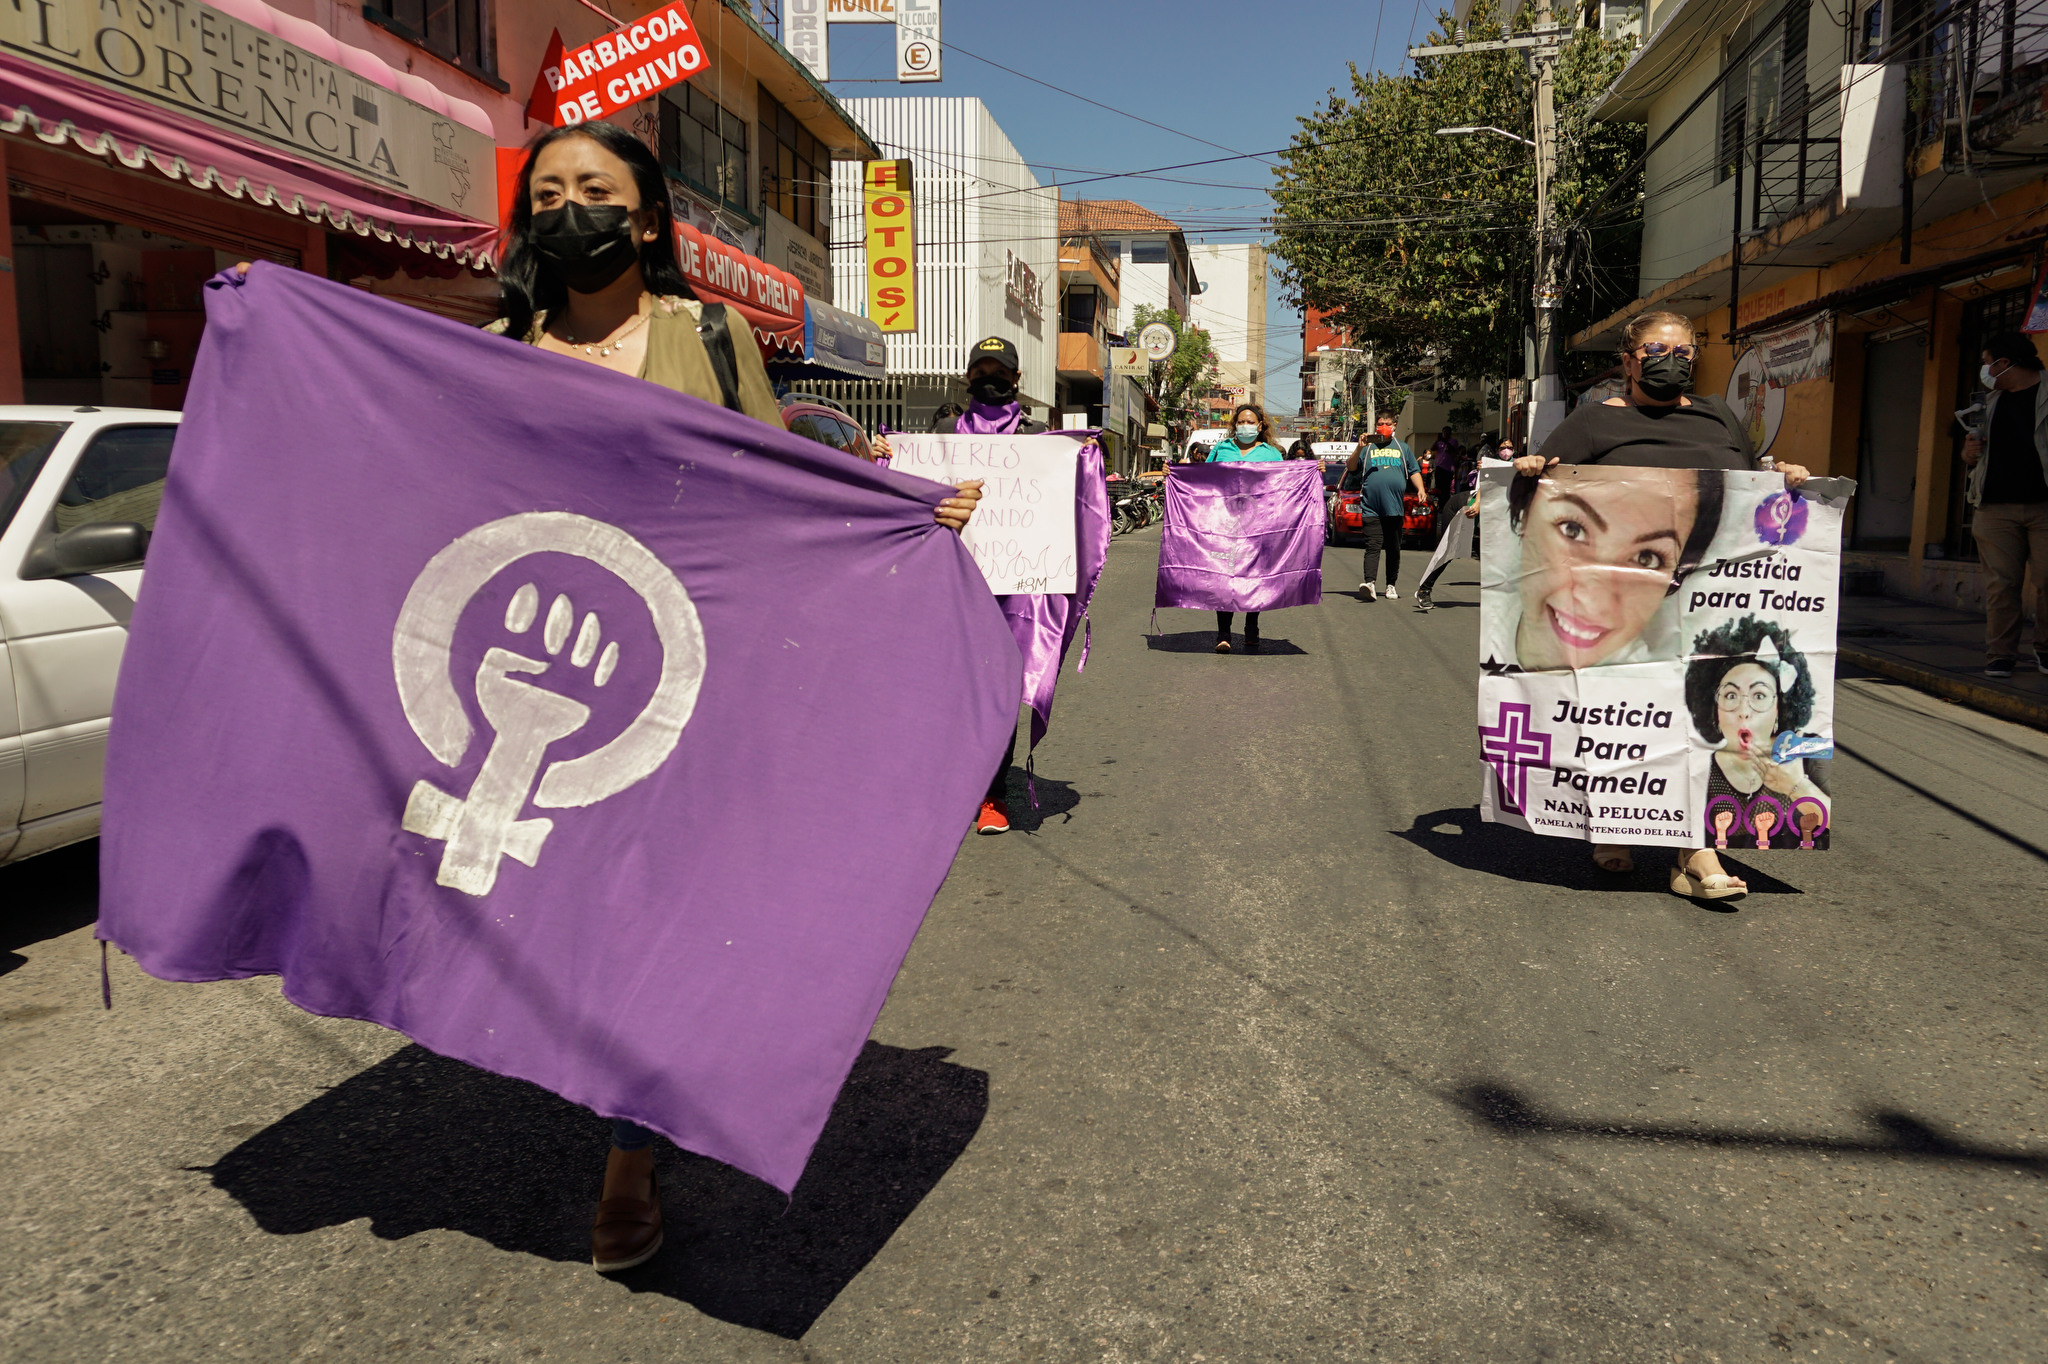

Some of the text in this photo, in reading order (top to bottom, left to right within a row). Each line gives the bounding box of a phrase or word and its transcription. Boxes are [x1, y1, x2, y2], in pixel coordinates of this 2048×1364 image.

[901, 27, 934, 40] FAX
[544, 9, 688, 93] BARBACOA
[911, 48, 925, 64] E
[12, 0, 400, 177] LORENCIA
[559, 44, 701, 126] DE CHIVO
[871, 166, 907, 308] FOTOS
[679, 234, 702, 279] DE
[705, 247, 749, 298] CHIVO
[896, 441, 1021, 469] MUJERES
[1370, 448, 1401, 458] LEGEND
[1371, 457, 1401, 466] STATUS
[1708, 556, 1802, 581] Justicia
[1012, 577, 1047, 594] #8M
[1688, 589, 1826, 612] para Todas
[1552, 700, 1673, 728] Justicia
[1574, 736, 1647, 761] Para
[1552, 767, 1667, 795] Pamela
[1544, 799, 1684, 821] NANA PELUCAS
[1534, 818, 1693, 838] PAMELA MONTENEGRO DEL REAL
